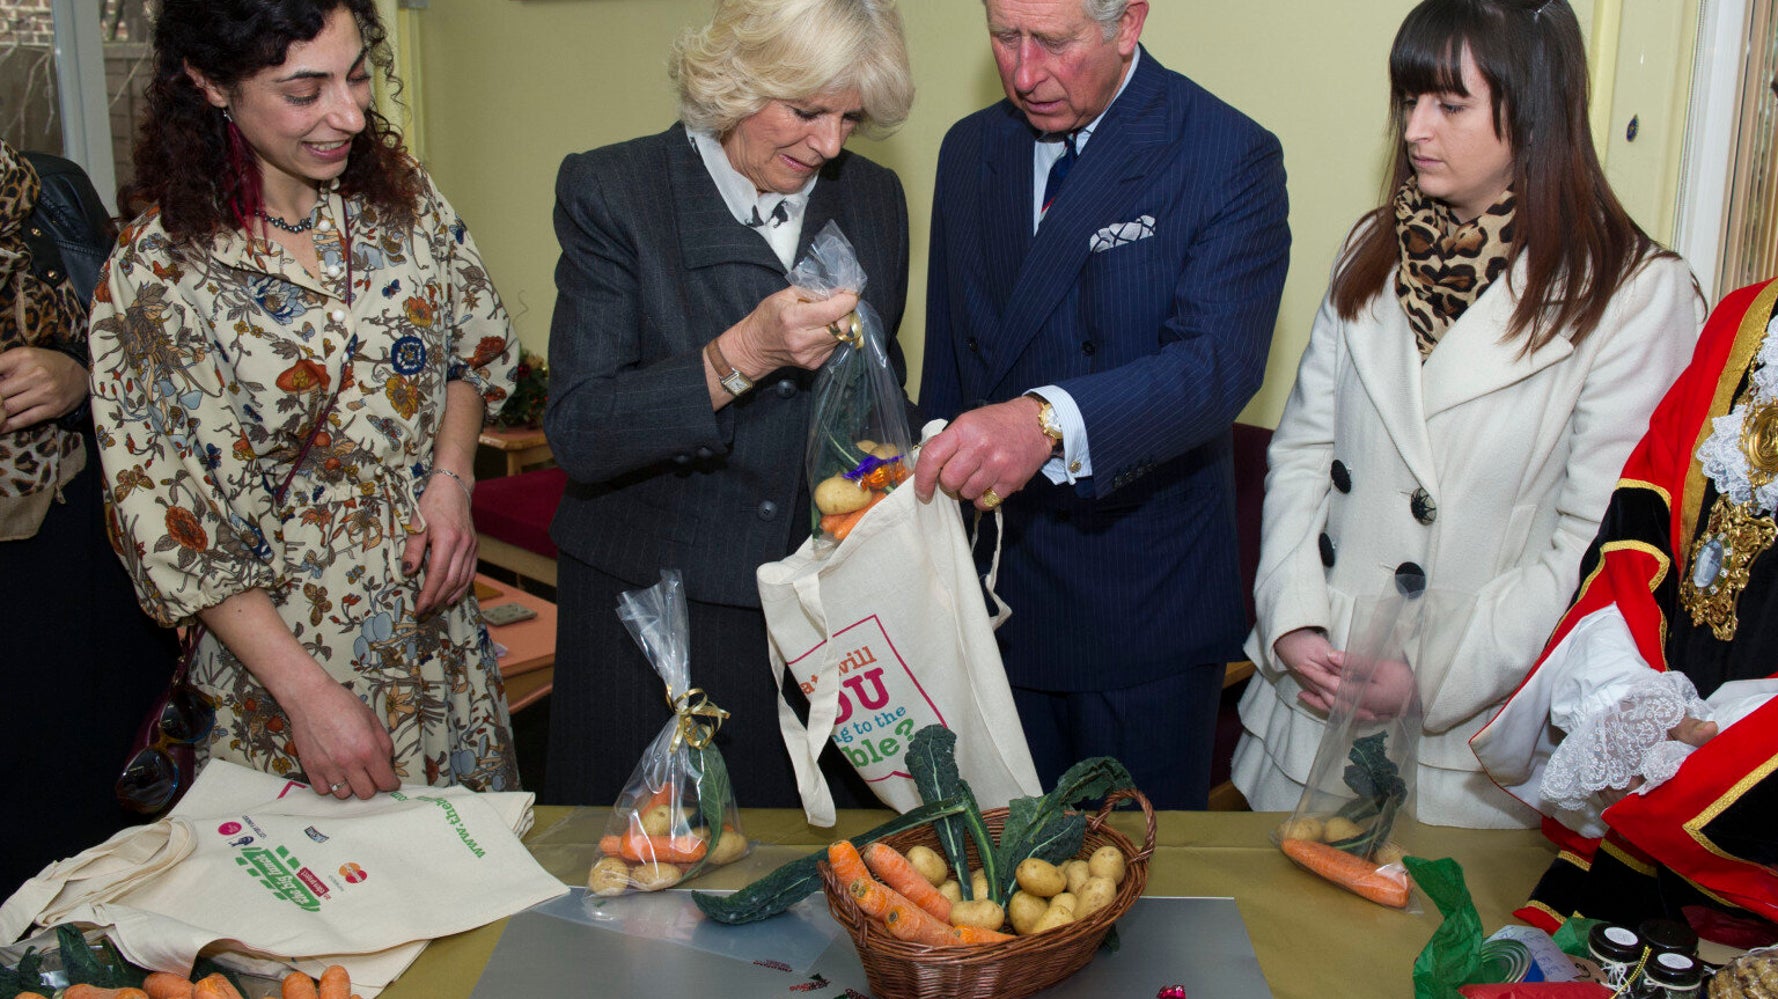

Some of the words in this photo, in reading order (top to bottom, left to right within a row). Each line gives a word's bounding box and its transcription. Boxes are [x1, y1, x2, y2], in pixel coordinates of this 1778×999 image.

[853, 721, 872, 735] to
[874, 706, 906, 727] the
[841, 718, 914, 768] ble?
[277, 875, 297, 891] big
